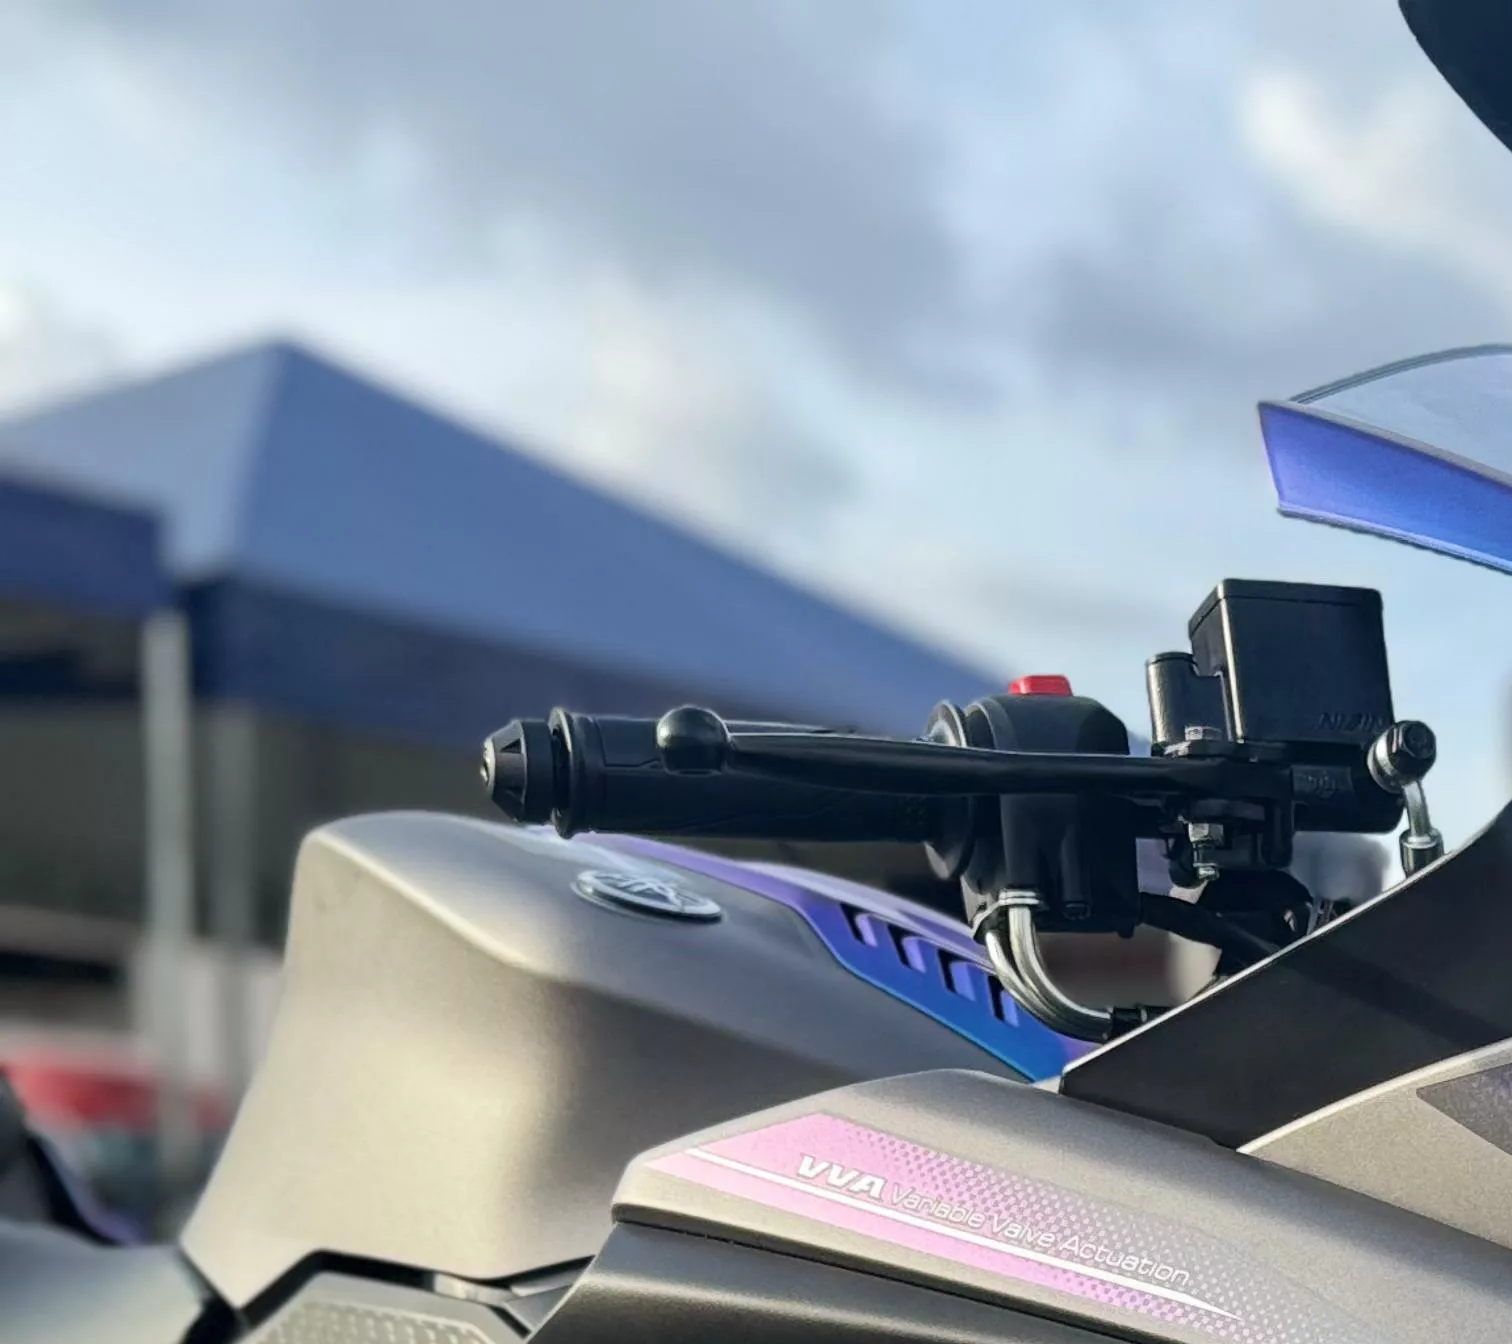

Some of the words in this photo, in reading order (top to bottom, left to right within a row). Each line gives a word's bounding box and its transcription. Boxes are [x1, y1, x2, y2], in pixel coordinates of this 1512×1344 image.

[796, 1154, 888, 1200] VVA
[890, 1185, 985, 1230] Variable
[989, 1214, 1056, 1248] Valve
[1059, 1235, 1191, 1284] Actuation
